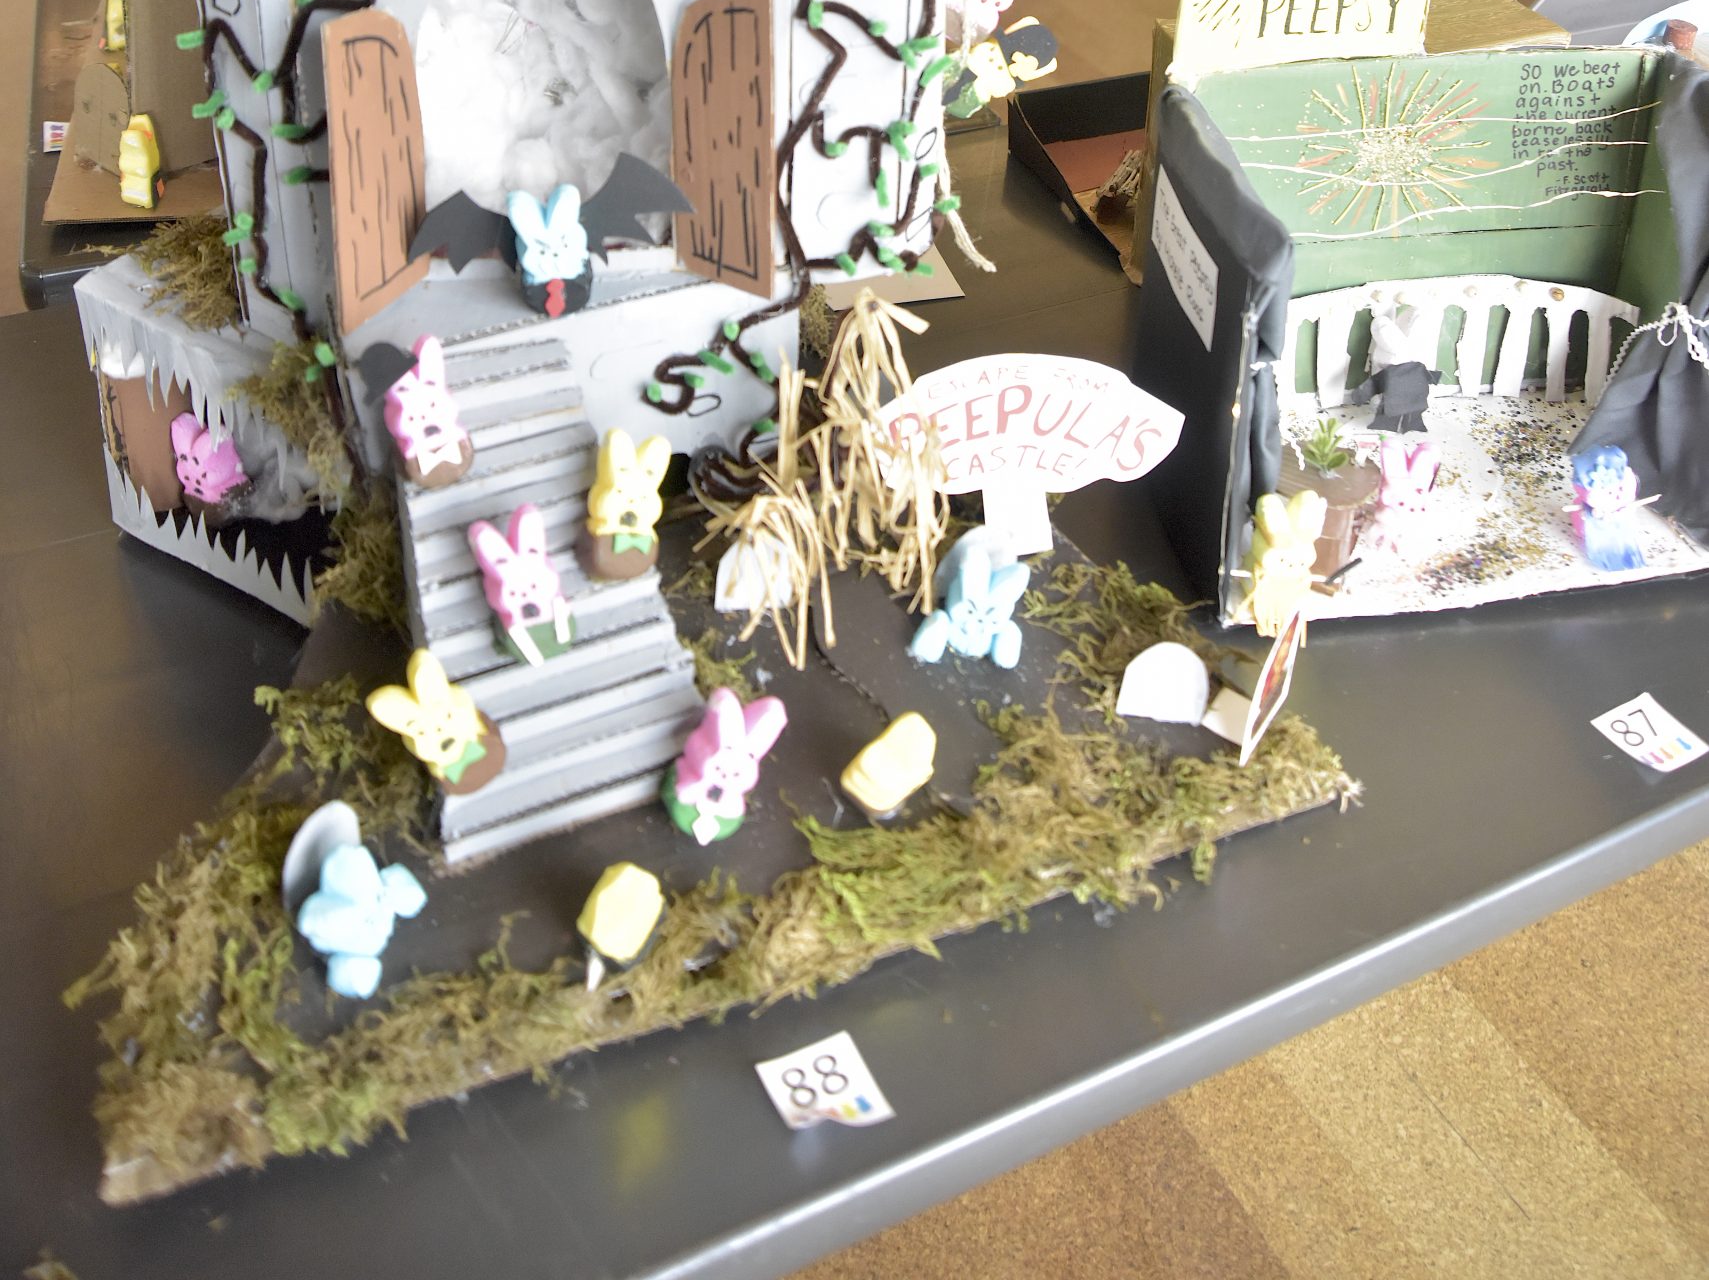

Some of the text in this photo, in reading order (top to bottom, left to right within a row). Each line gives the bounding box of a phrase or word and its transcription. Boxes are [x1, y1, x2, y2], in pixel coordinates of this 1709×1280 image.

[1583, 60, 1621, 75] beat
[1515, 93, 1601, 113] against
[1515, 105, 1617, 123] the current
[1512, 122, 1613, 139] borne back
[1537, 160, 1579, 178] past.
[928, 365, 1029, 400] ESAPE
[1610, 709, 1658, 747] 87
[781, 1054, 848, 1109] 88
